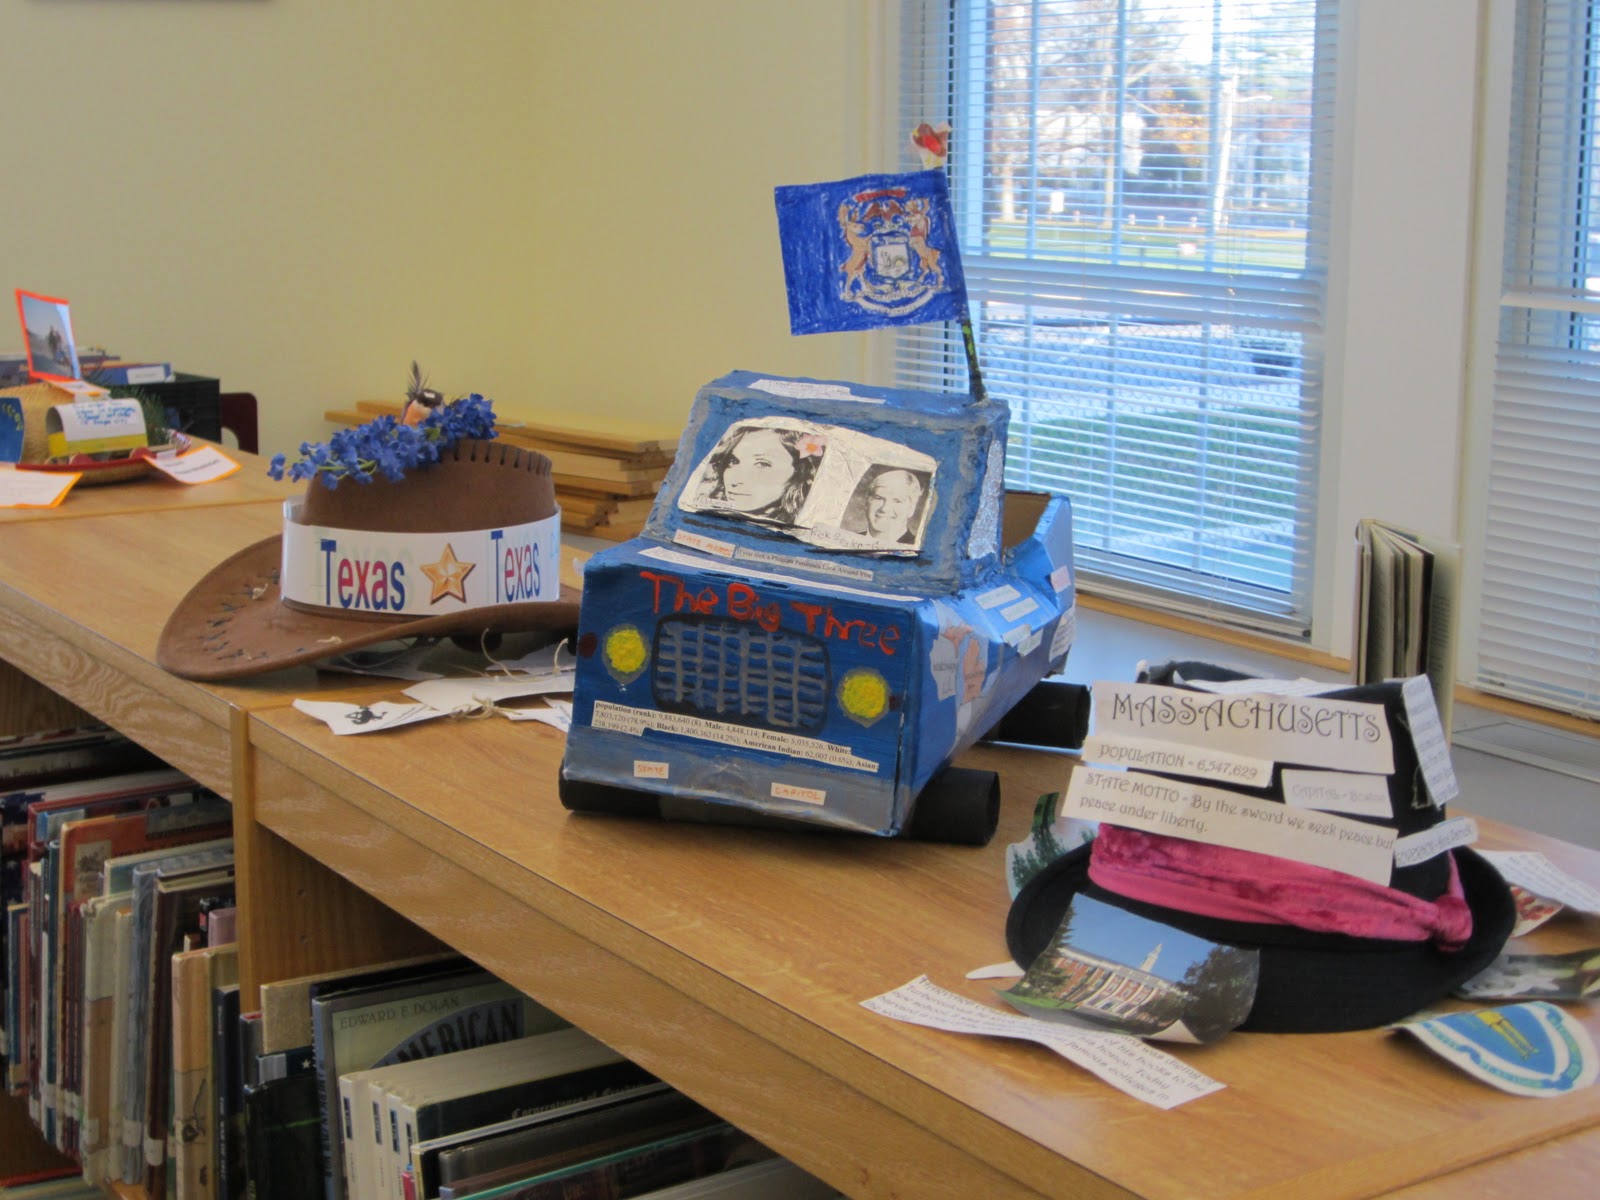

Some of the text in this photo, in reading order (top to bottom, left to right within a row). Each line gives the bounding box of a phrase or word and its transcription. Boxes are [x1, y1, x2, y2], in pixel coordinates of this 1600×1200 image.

[677, 533, 702, 547] STATE
[810, 525, 831, 539] Rick
[321, 539, 405, 611] Texas
[491, 530, 541, 603] Texas
[754, 551, 766, 559] seek
[795, 560, 821, 569] Peninsula
[822, 564, 837, 572] Look
[839, 567, 859, 576] Around
[860, 570, 872, 579] You
[640, 571, 899, 655] The Big Three
[595, 702, 632, 714] population
[633, 708, 657, 720] (rank):
[659, 713, 690, 725] 9,883,640
[704, 720, 724, 731] Male:
[762, 731, 789, 743] Female:
[827, 744, 852, 755] White:
[1112, 693, 1381, 743] MASSACHUSETTS
[656, 722, 679, 733] Black:
[680, 726, 712, 738] 1,400,362
[743, 738, 777, 751] American
[778, 745, 803, 757] Indian:
[805, 750, 828, 761] 62,007
[856, 759, 879, 771] Asian:
[1098, 743, 1185, 769] POPULATION
[1196, 759, 1258, 780] 6,547,629
[638, 764, 665, 776] STATE
[775, 786, 821, 801] CAPITOL
[1080, 796, 1208, 834] peace under liberty.
[1085, 771, 1131, 793] STATE
[1131, 780, 1180, 805] MOTTO
[1190, 795, 1211, 814] By
[1215, 797, 1238, 816] the
[1241, 805, 1284, 825] sword
[1287, 815, 1305, 831] we
[1306, 819, 1338, 837] seek
[1339, 826, 1374, 847] peace
[340, 1008, 396, 1029] EDWARD
[413, 995, 460, 1015] DOLAN
[400, 1003, 518, 1063] ERICAN
